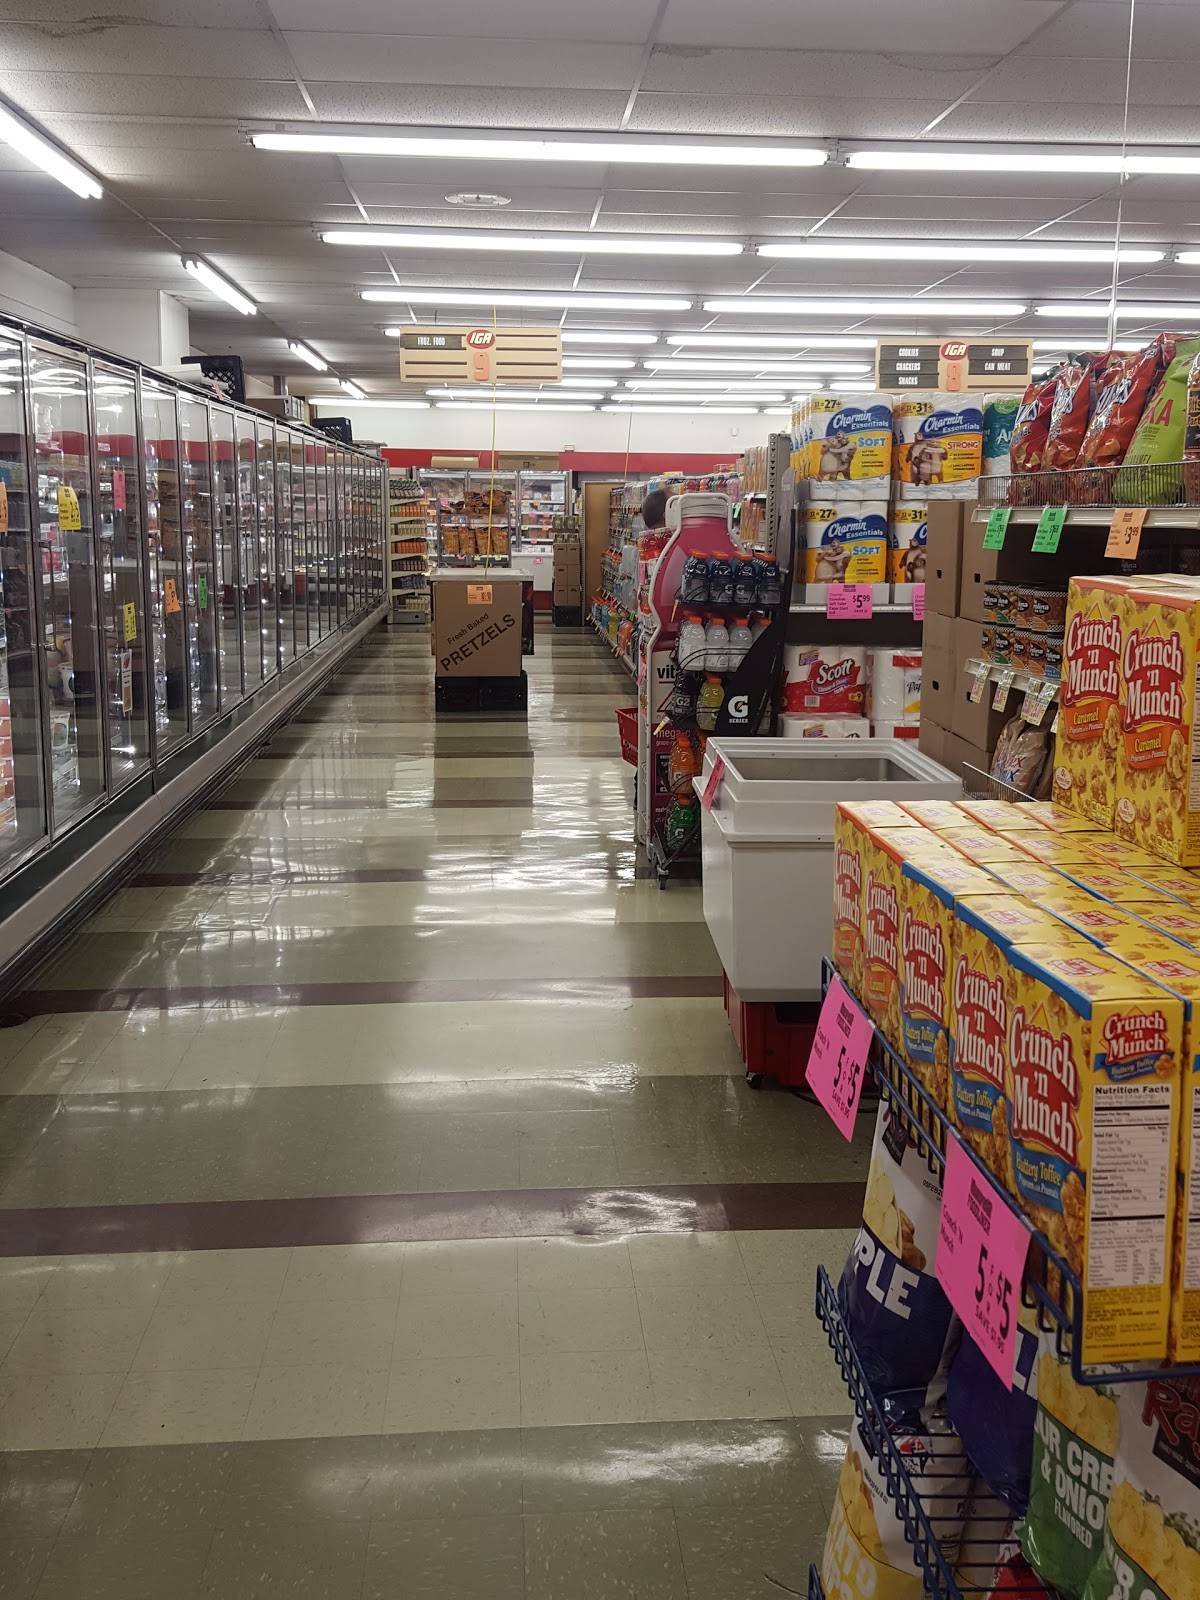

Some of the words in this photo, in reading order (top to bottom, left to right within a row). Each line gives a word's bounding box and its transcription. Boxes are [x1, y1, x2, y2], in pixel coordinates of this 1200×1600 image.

[470, 332, 493, 344] IGA
[944, 344, 967, 356] IGA
[832, 411, 872, 429] Charmin
[852, 420, 889, 430] Essentials
[924, 414, 964, 432] Charmin
[942, 423, 980, 434] Essentials
[858, 437, 886, 447] SOFT
[947, 442, 978, 450] STRONG
[828, 520, 867, 538] Charmin
[846, 529, 884, 539] Essentials
[852, 546, 880, 556] SOFT
[447, 630, 467, 644] Fresh
[467, 612, 489, 631] Baked
[1068, 614, 1120, 657] Crunch
[440, 614, 516, 671] PRETZELS
[1124, 632, 1182, 680] Crunch
[816, 659, 854, 684] Scott
[1066, 658, 1118, 699] Munch
[676, 696, 690, 706] G2
[728, 695, 748, 718] G
[1127, 680, 1180, 724] Munch
[1074, 707, 1098, 725] Caramel
[1135, 733, 1162, 752] Caramel
[867, 875, 898, 930] Crunch
[867, 920, 897, 970] Munch
[903, 912, 944, 973] Crunch
[904, 962, 942, 1018] Munch
[956, 960, 1005, 1032] Crunch
[1104, 1012, 1164, 1040] Crunch
[956, 1014, 1003, 1084] Munch
[1011, 1012, 1075, 1098] Crunch
[1108, 1034, 1164, 1061] Munch
[834, 1046, 846, 1087] 5
[848, 1060, 860, 1108] $5
[1095, 1086, 1140, 1094] Nutrition
[1142, 1085, 1170, 1093] Facts
[1014, 1074, 1074, 1158] Munch
[1016, 1152, 1038, 1182] Buttery
[1040, 1161, 1061, 1186] Toffee
[975, 1244, 988, 1303] 5
[996, 1270, 1012, 1340] $5
[1054, 1498, 1092, 1550] FLAVORED
